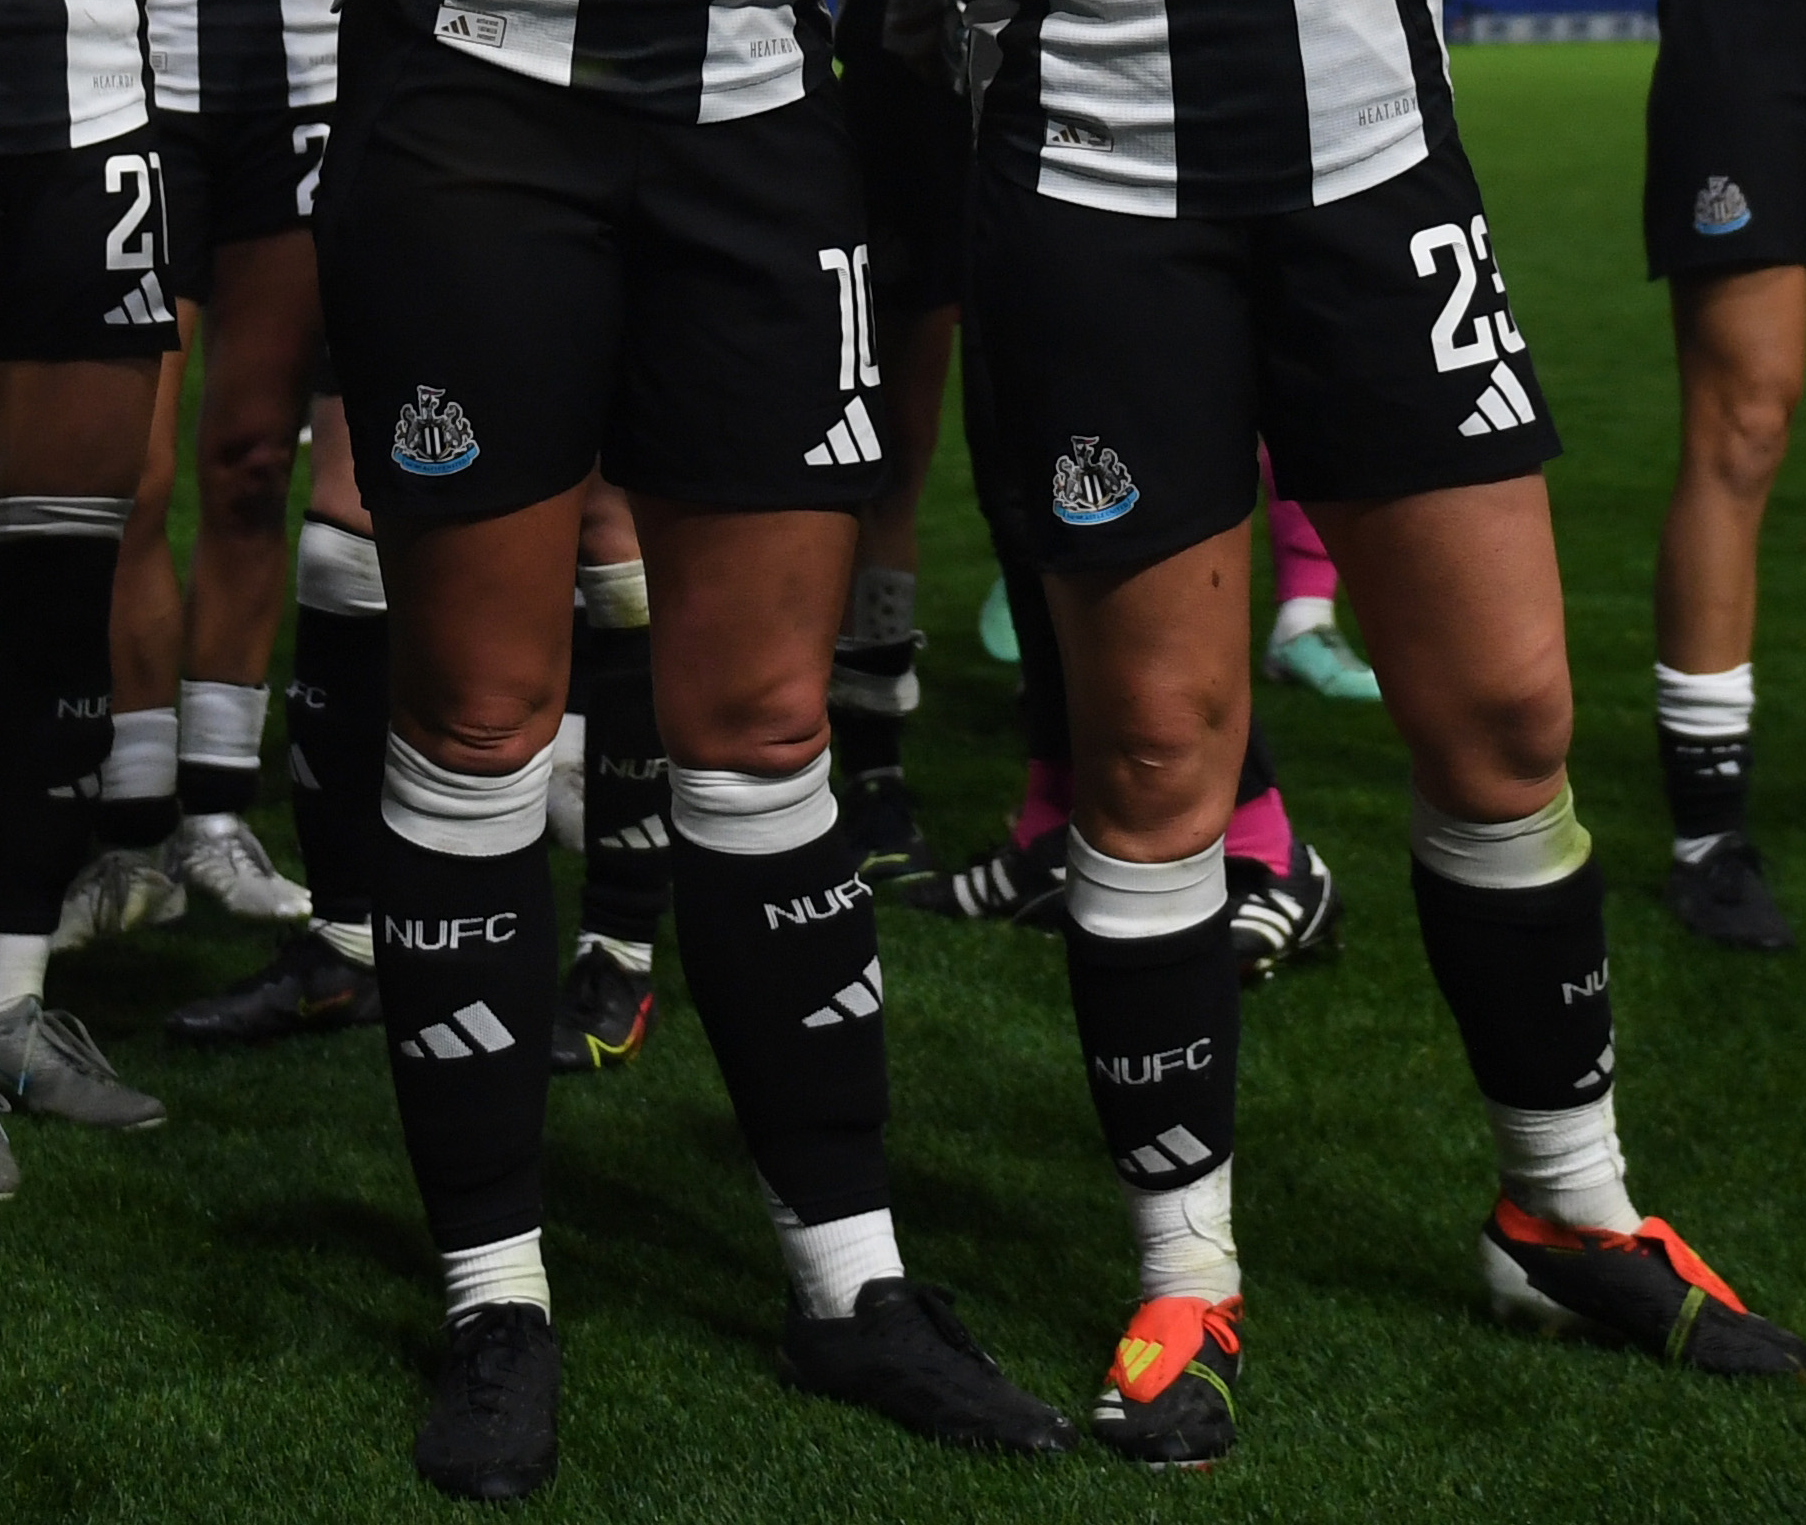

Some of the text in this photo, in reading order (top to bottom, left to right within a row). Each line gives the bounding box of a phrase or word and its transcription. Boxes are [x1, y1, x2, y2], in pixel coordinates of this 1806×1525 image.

[1358, 97, 1416, 126] HEAT.RDY
[818, 243, 882, 391] 10
[1409, 214, 1526, 373] 23
[385, 911, 518, 950] NUFC
[1095, 1036, 1213, 1086] NUFC
